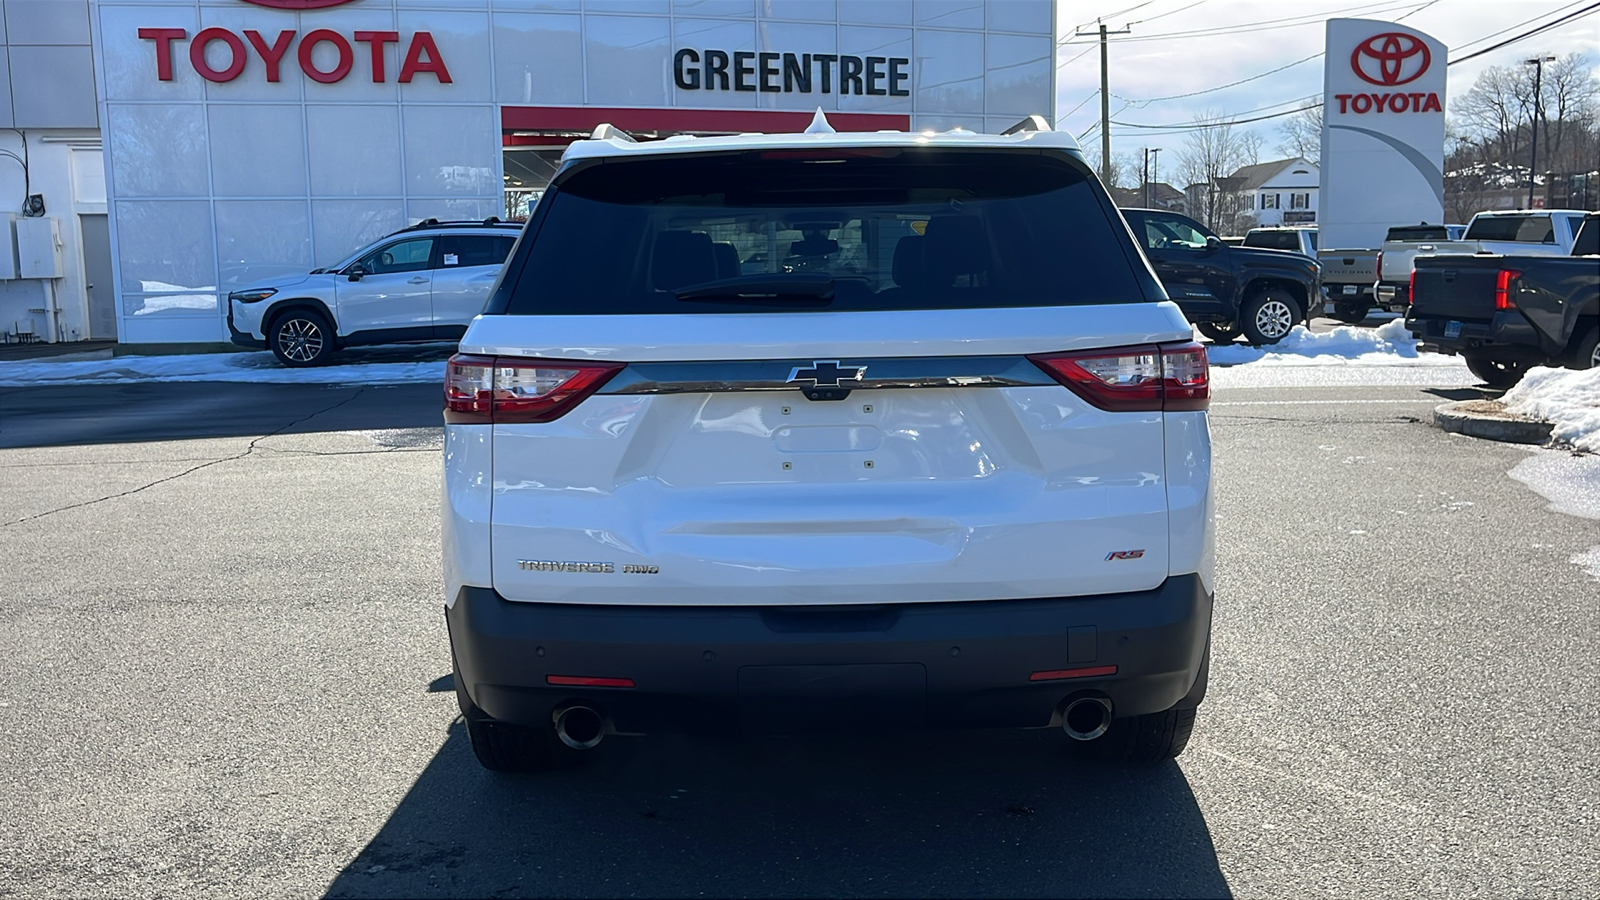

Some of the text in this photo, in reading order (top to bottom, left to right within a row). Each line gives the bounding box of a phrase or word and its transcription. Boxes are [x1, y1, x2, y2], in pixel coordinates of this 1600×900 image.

[137, 27, 453, 84] TOYOTA
[674, 48, 909, 97] GREENTREE
[1335, 92, 1442, 115] TOYOTA
[516, 558, 660, 574] TRAVERSE AWD
[1104, 549, 1146, 561] RS
